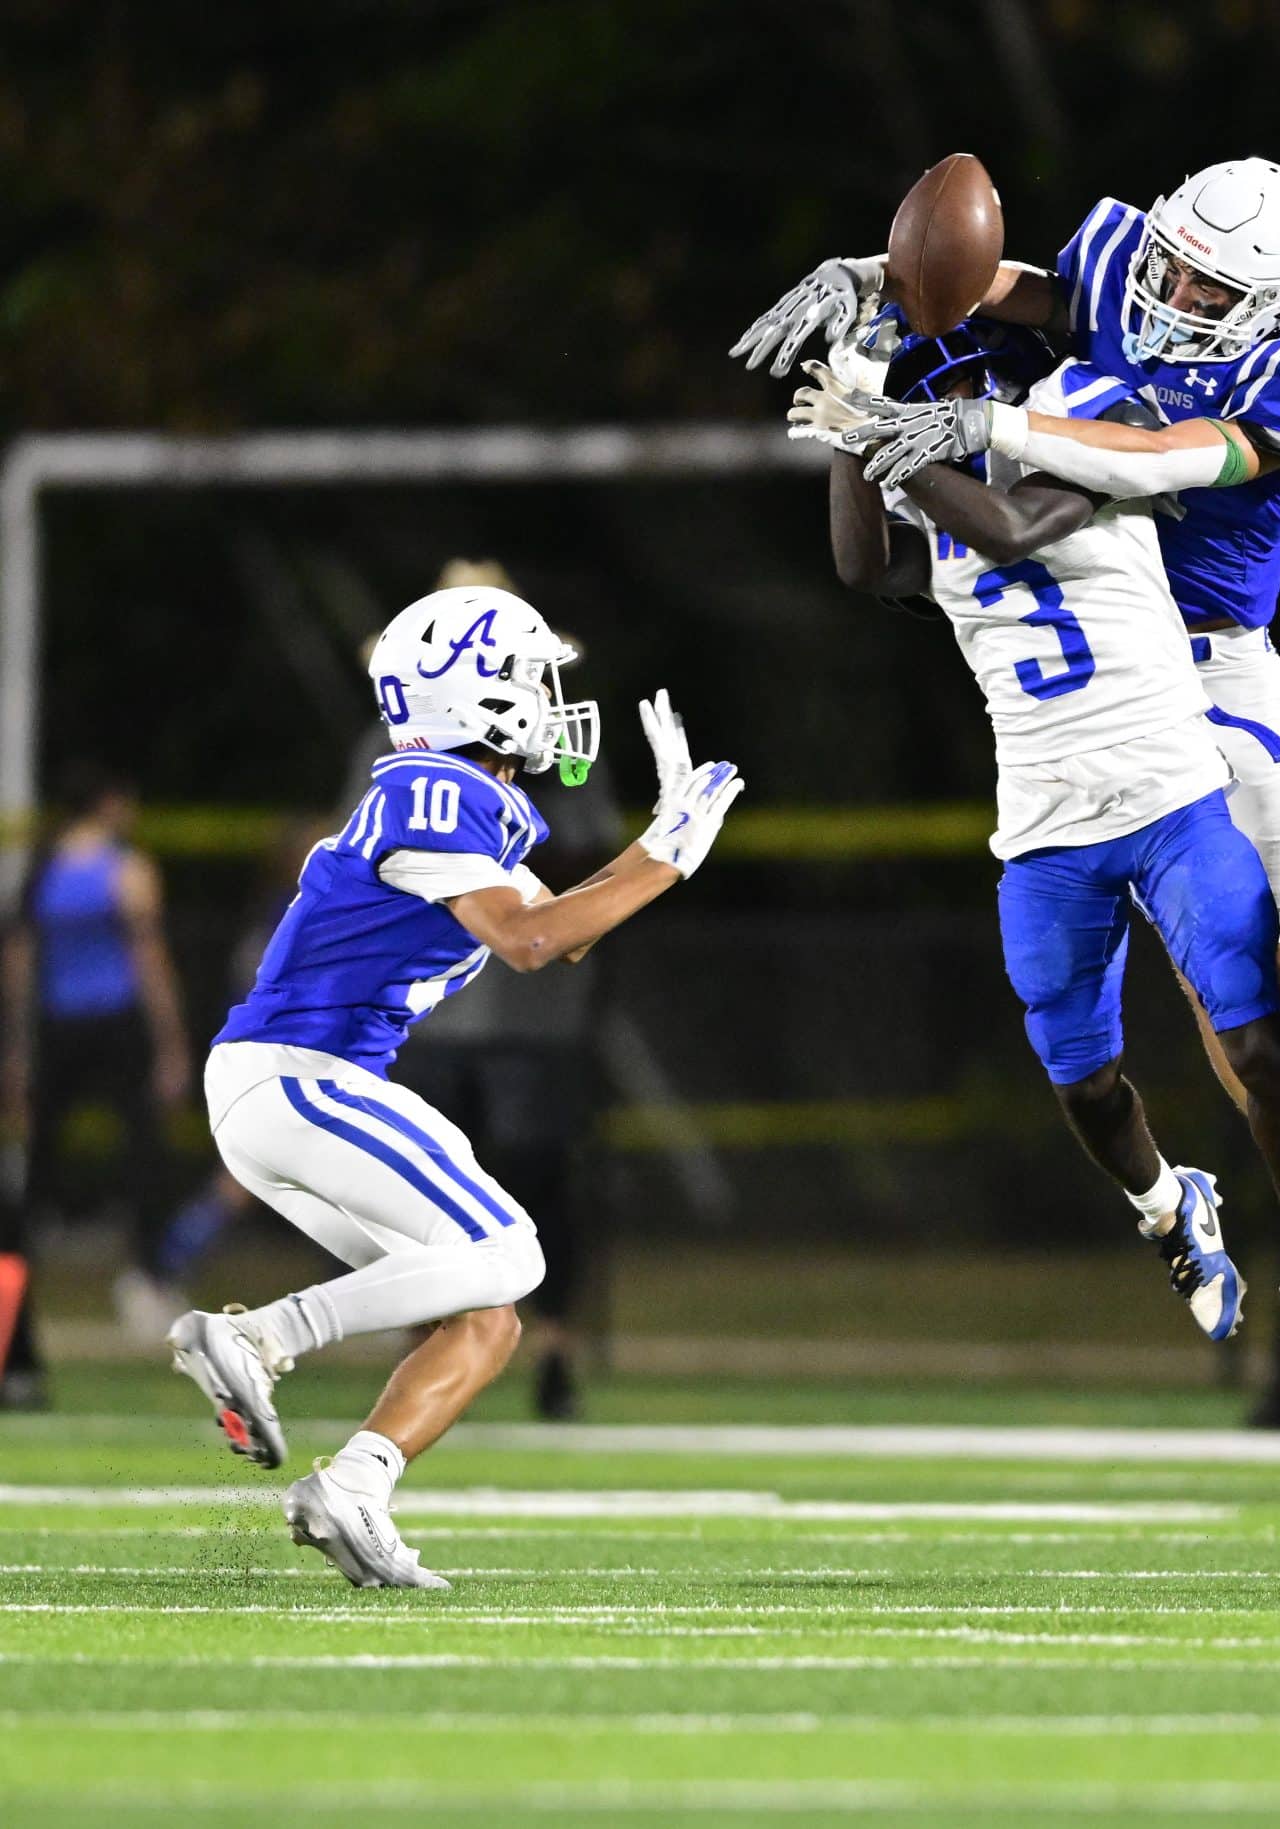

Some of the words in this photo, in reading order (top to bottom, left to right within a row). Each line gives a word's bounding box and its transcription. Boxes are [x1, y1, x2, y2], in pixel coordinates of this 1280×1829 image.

[1177, 226, 1213, 255] Riddell
[1156, 386, 1195, 410] ONS
[416, 608, 501, 679] A
[971, 558, 1096, 701] 3
[408, 776, 461, 834] 10
